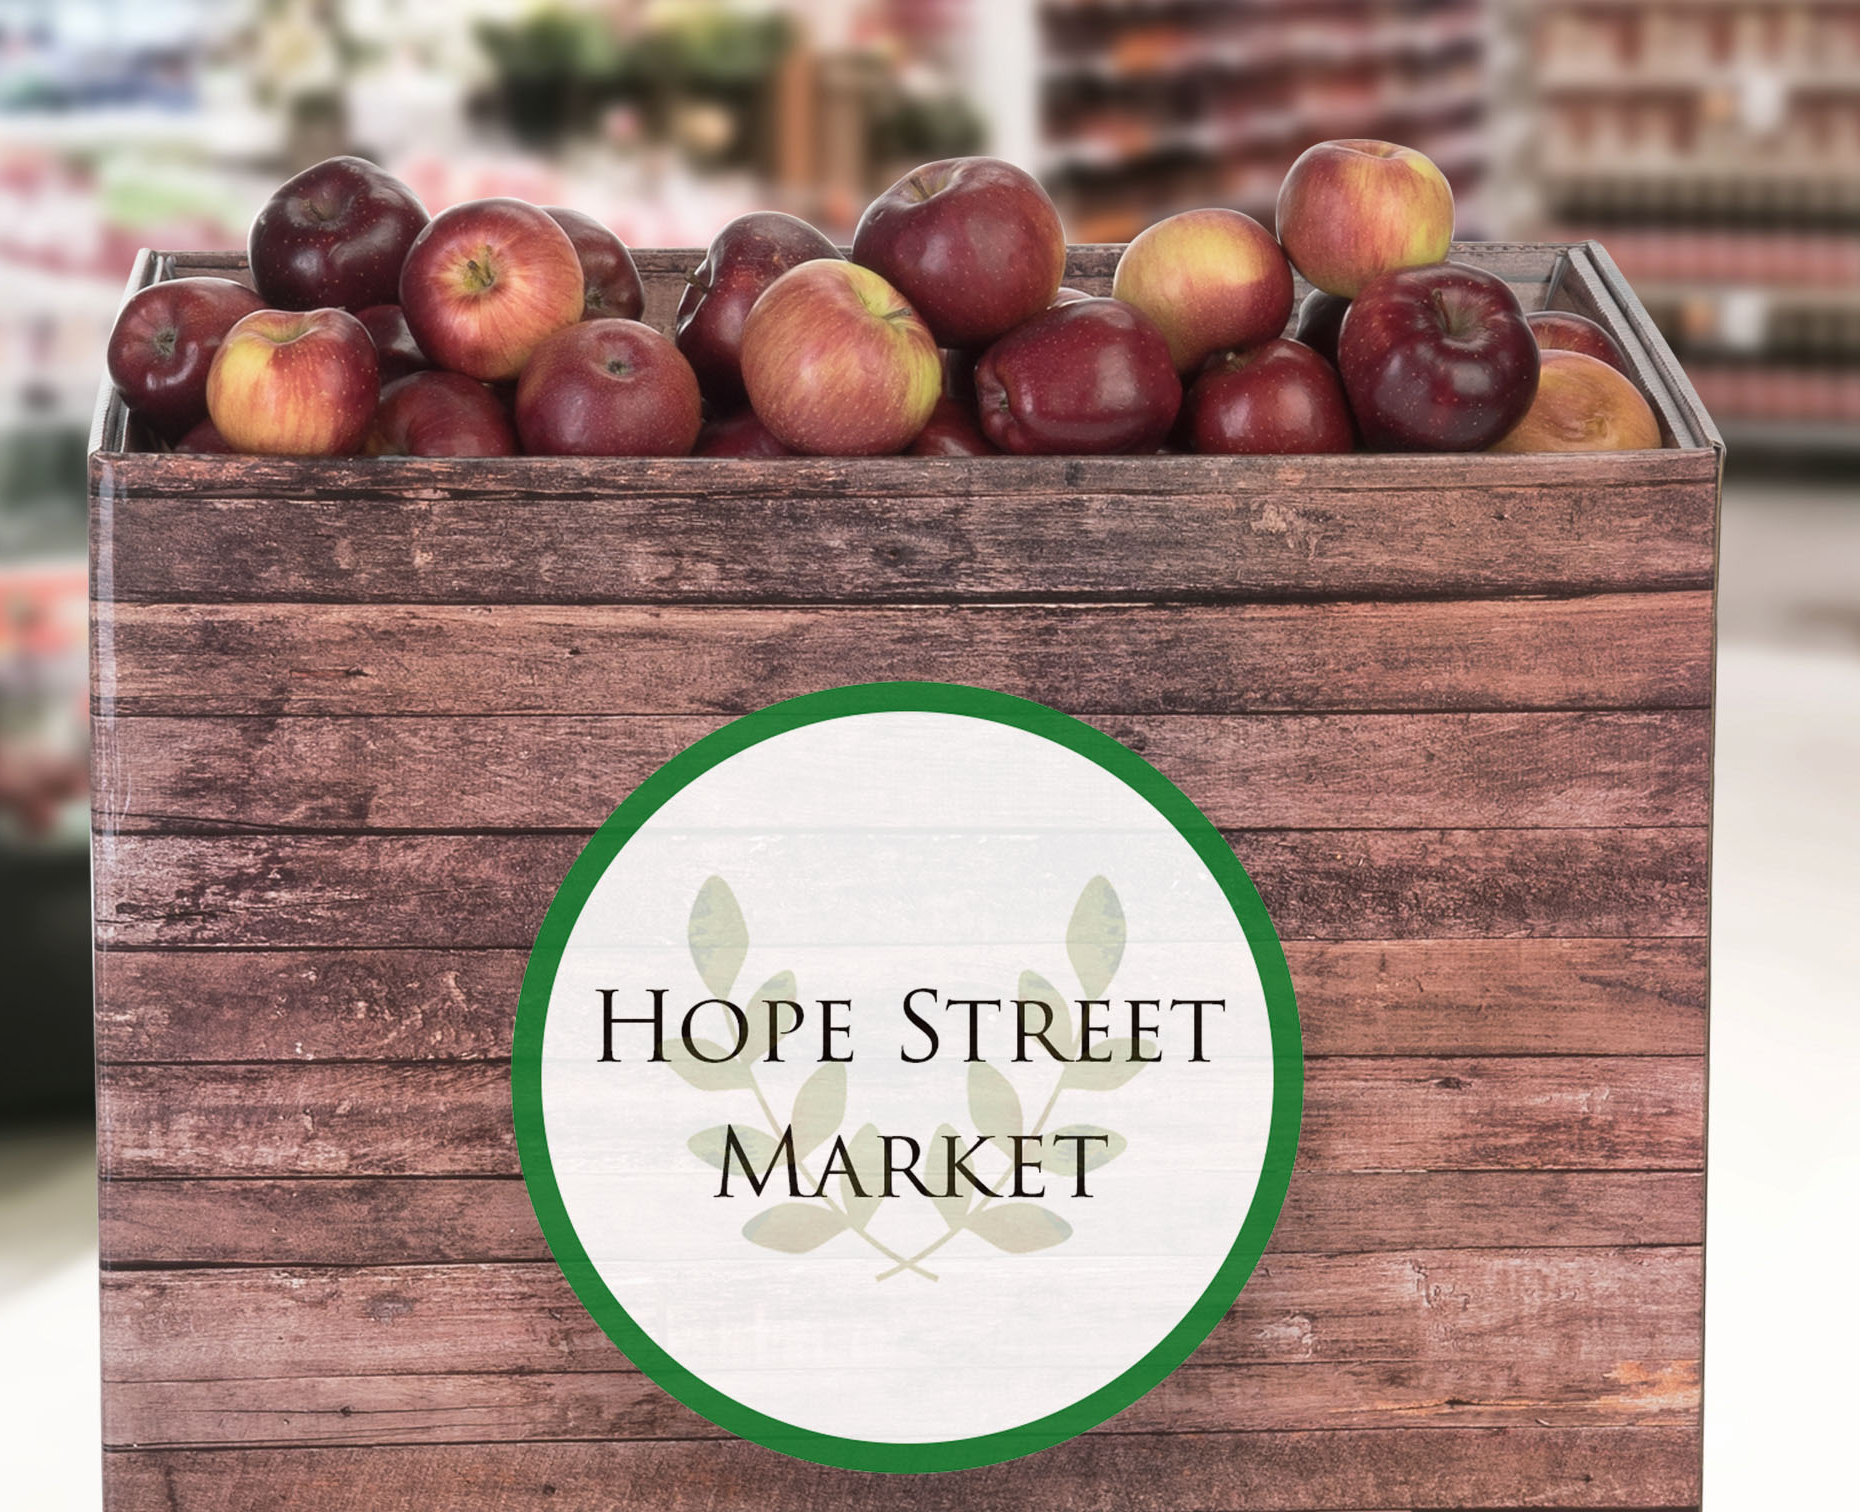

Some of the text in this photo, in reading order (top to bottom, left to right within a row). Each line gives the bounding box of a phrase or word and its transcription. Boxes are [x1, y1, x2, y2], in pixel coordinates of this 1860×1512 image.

[595, 987, 1226, 1064] HOPE STREET
[713, 1123, 1110, 1199] MARKET
